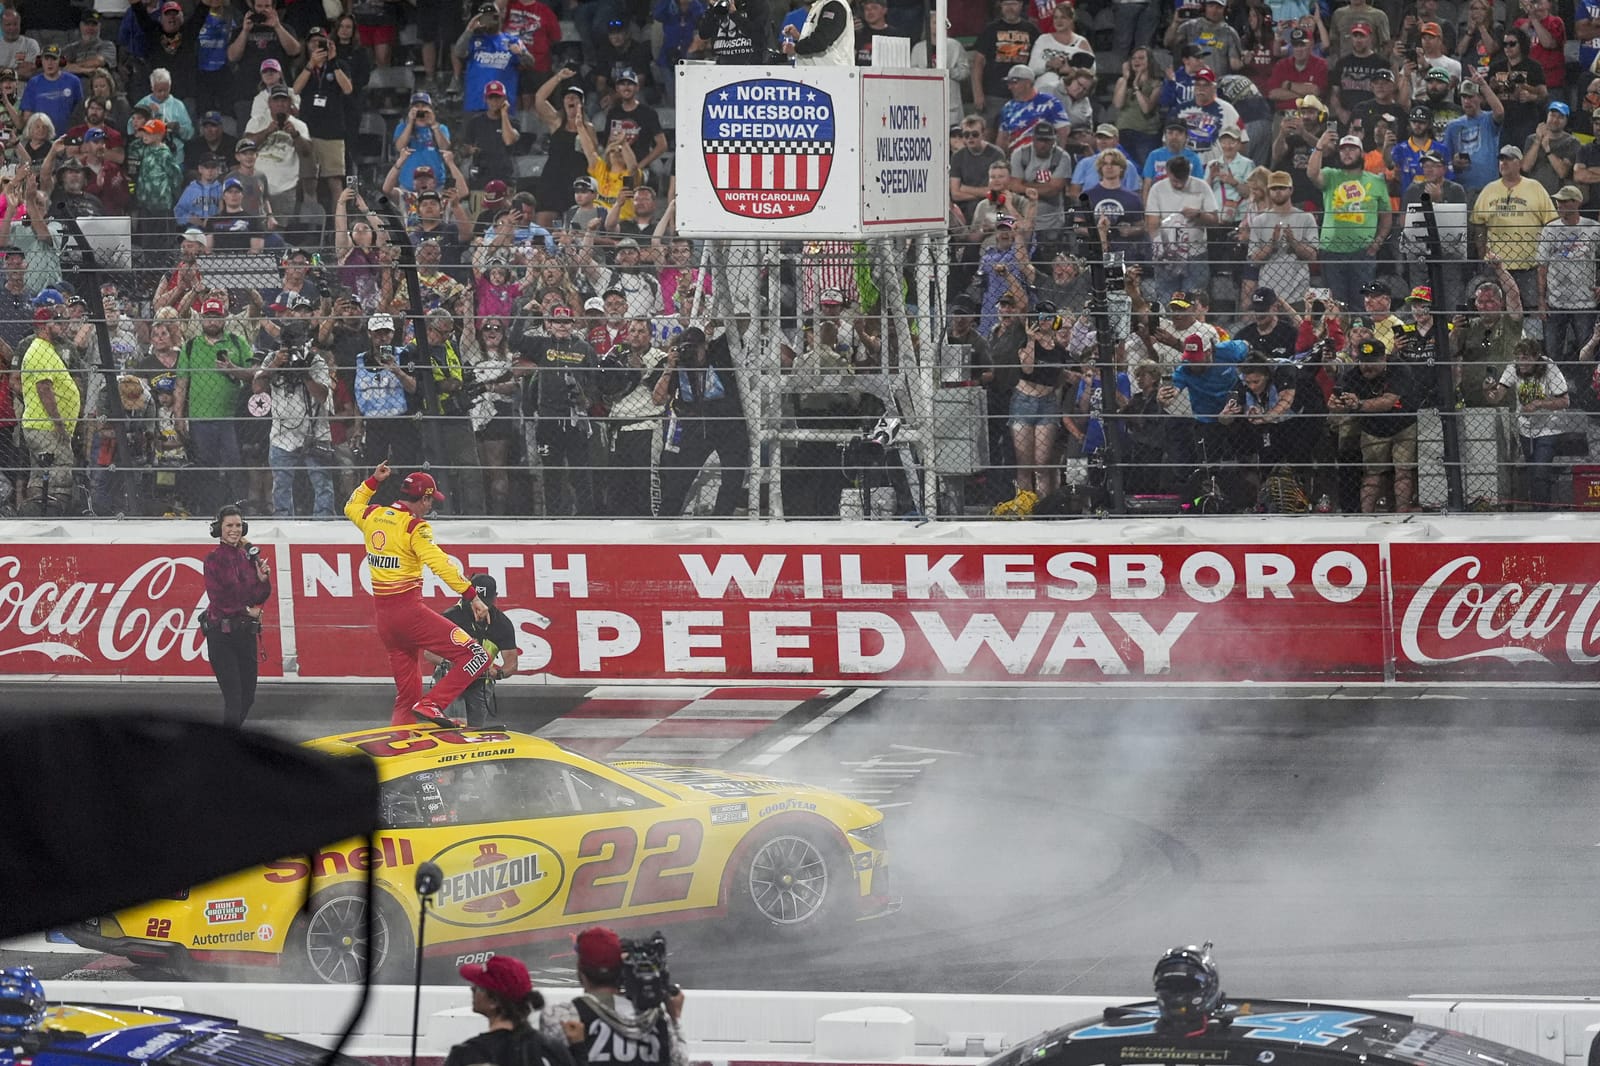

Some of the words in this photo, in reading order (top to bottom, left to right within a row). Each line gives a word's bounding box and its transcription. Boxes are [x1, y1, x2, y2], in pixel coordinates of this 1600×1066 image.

[737, 86, 800, 101] NORTH
[707, 104, 830, 120] WILKESBORO
[889, 105, 919, 129] NORTH
[719, 123, 819, 138] SPEEDWAY
[876, 137, 932, 162] WILKESBORO
[880, 169, 929, 194] SPEEDWAY
[725, 192, 758, 201] NORTH
[760, 192, 810, 202] CAROLINA
[752, 203, 783, 214] USA
[367, 553, 400, 569] ENNZOIL
[302, 552, 588, 599] NRTH
[679, 551, 1369, 603] WILKESBORO
[0, 556, 212, 662] oca-Col
[494, 608, 1198, 675] SPEEDWAY
[437, 753, 467, 763] JOEY
[471, 748, 515, 759] LOGANO
[759, 799, 817, 817] GOODYEAR
[563, 818, 704, 916] 22
[438, 855, 543, 906] PENNZOIL
[207, 906, 245, 916] BROTHERS
[215, 901, 236, 909] HUNT
[215, 913, 238, 921] PIZZA
[146, 918, 172, 938] 22
[192, 930, 255, 946] Autotrader
[455, 951, 495, 967] FORD
